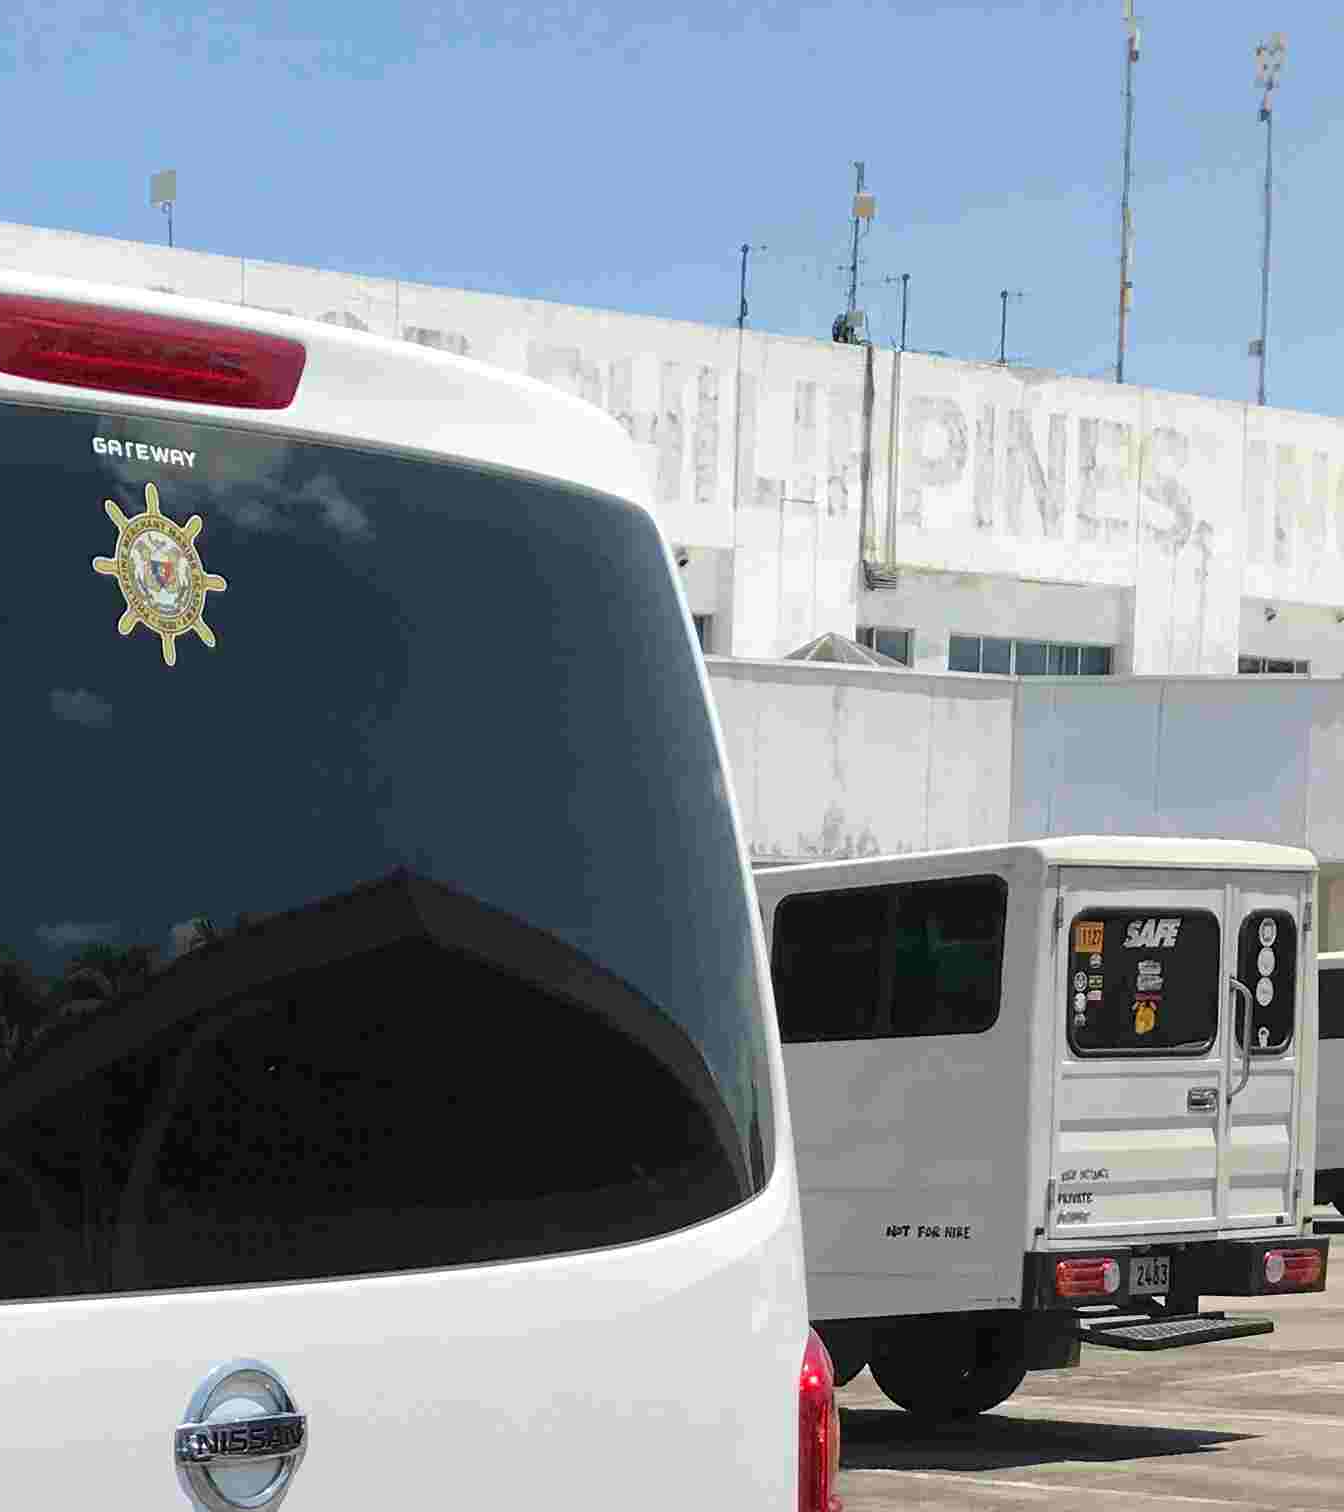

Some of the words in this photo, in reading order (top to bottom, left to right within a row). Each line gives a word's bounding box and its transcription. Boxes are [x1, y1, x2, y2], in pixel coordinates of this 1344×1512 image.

[92, 436, 197, 468] GATEWAY
[1122, 917, 1182, 949] SAFE
[886, 1224, 911, 1238] NOT
[917, 1224, 941, 1239] FOR
